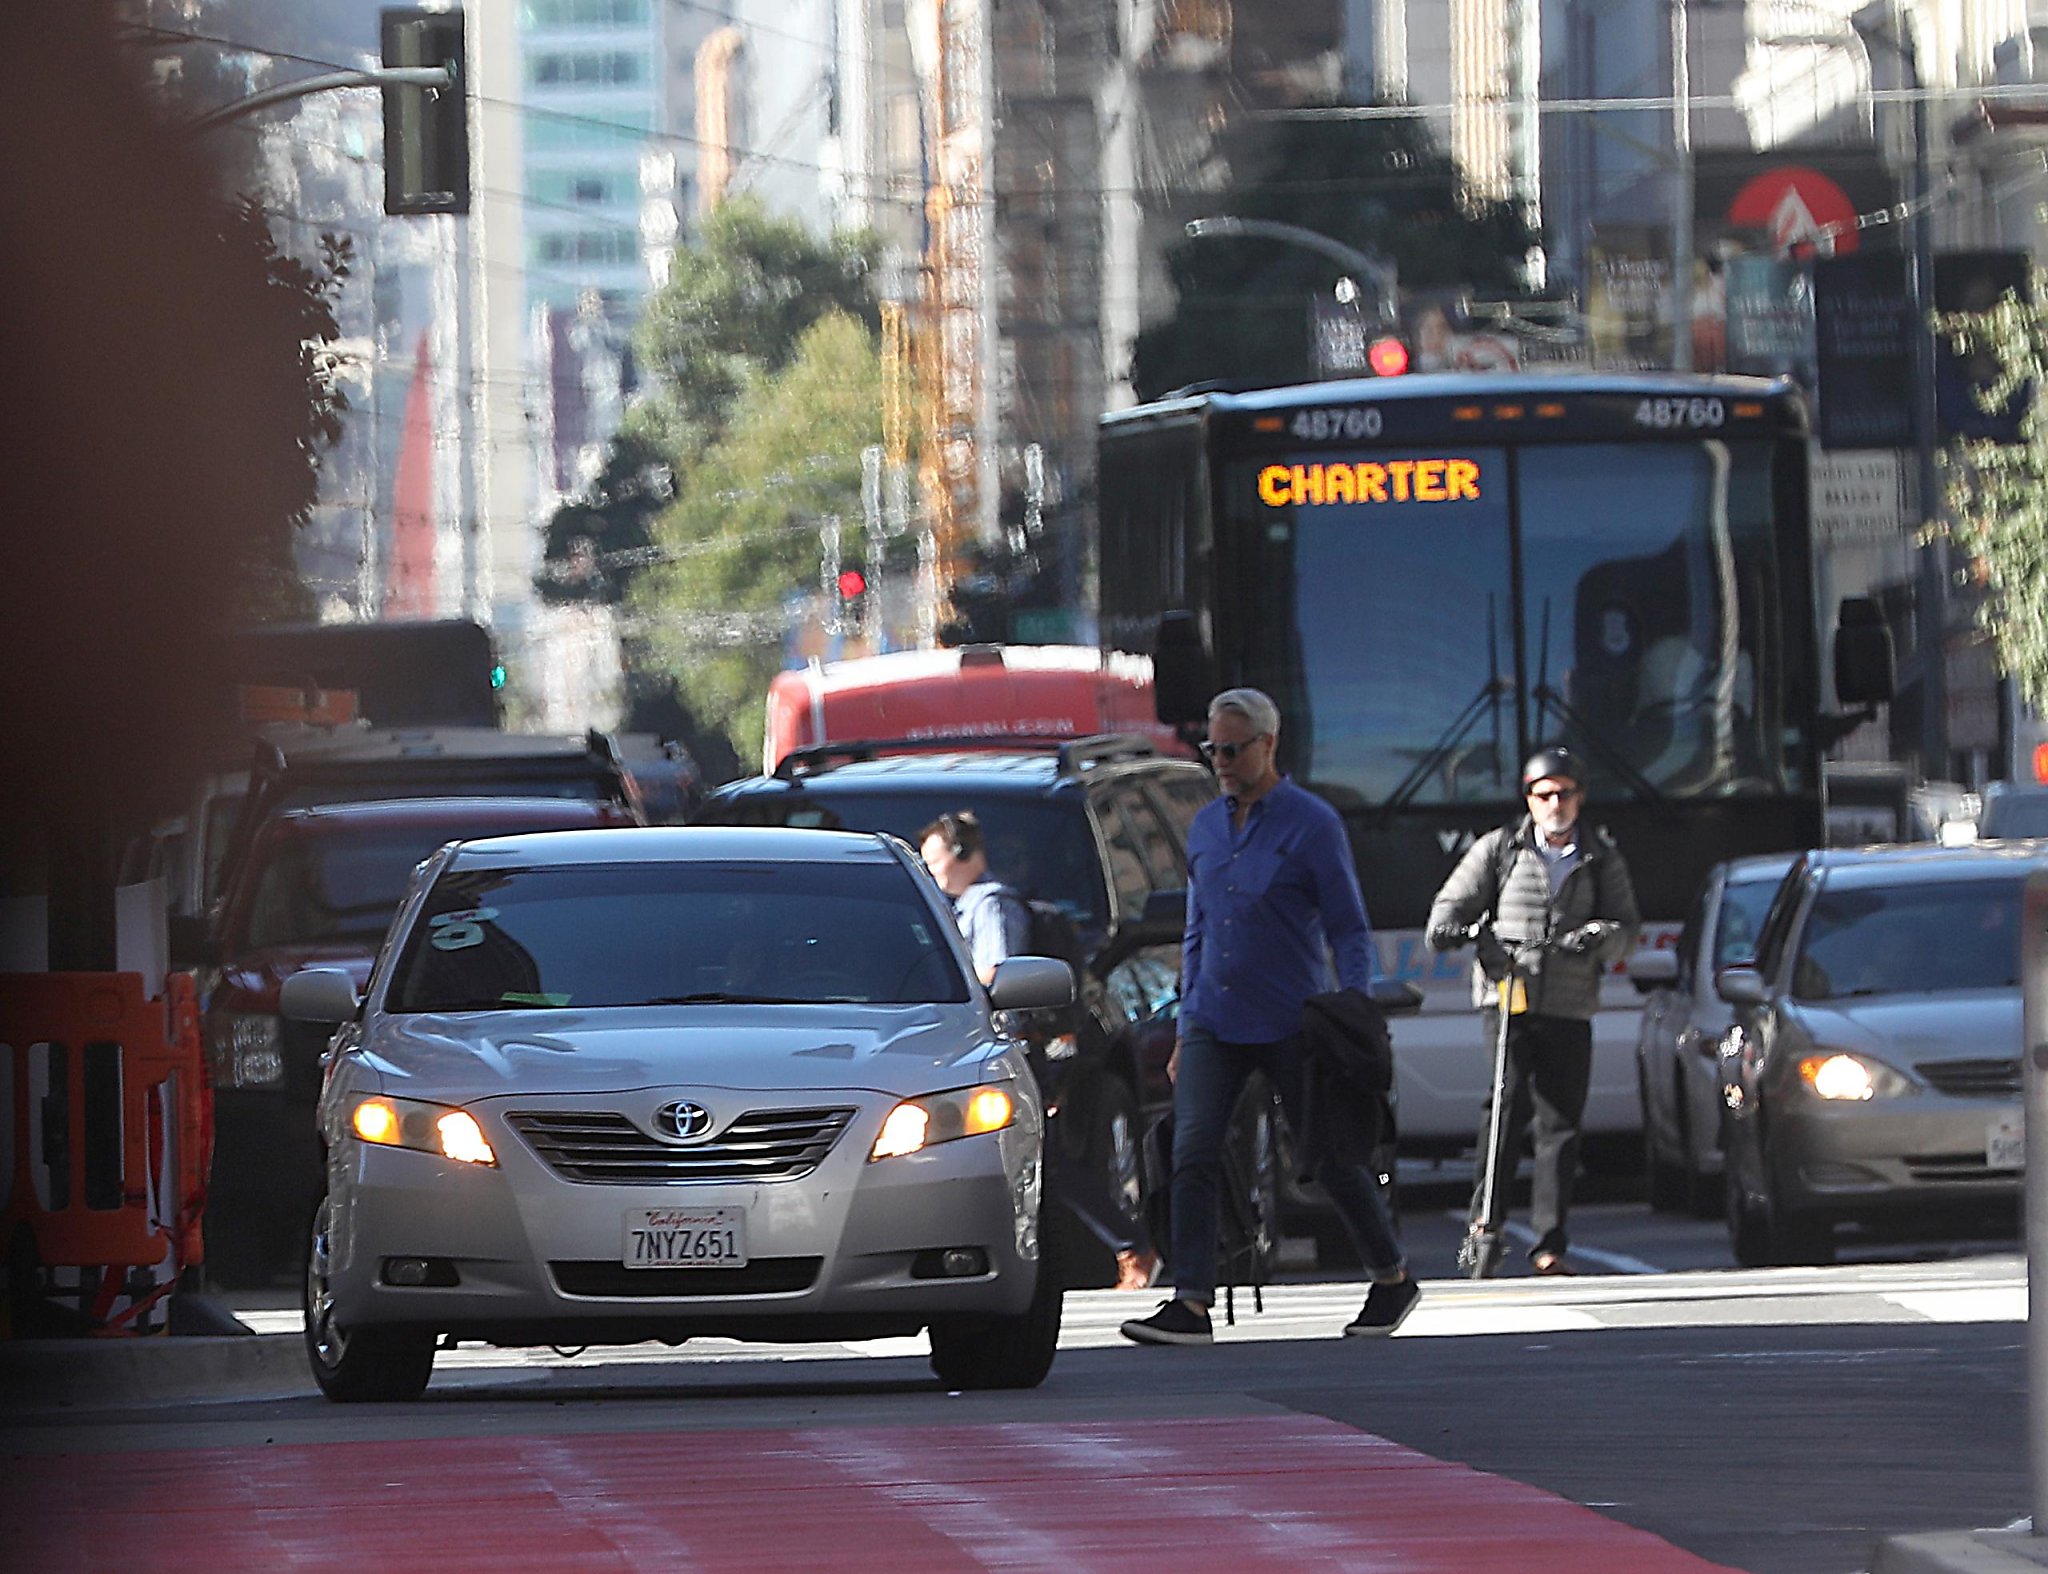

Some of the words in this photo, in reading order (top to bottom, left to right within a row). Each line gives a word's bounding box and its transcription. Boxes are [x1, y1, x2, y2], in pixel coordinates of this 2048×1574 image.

[1291, 407, 1383, 438] 48760
[1634, 398, 1725, 428] 48760
[1258, 458, 1480, 506] CHARTER
[648, 1211, 723, 1229] California
[632, 1230, 738, 1259] 7NYZ651
